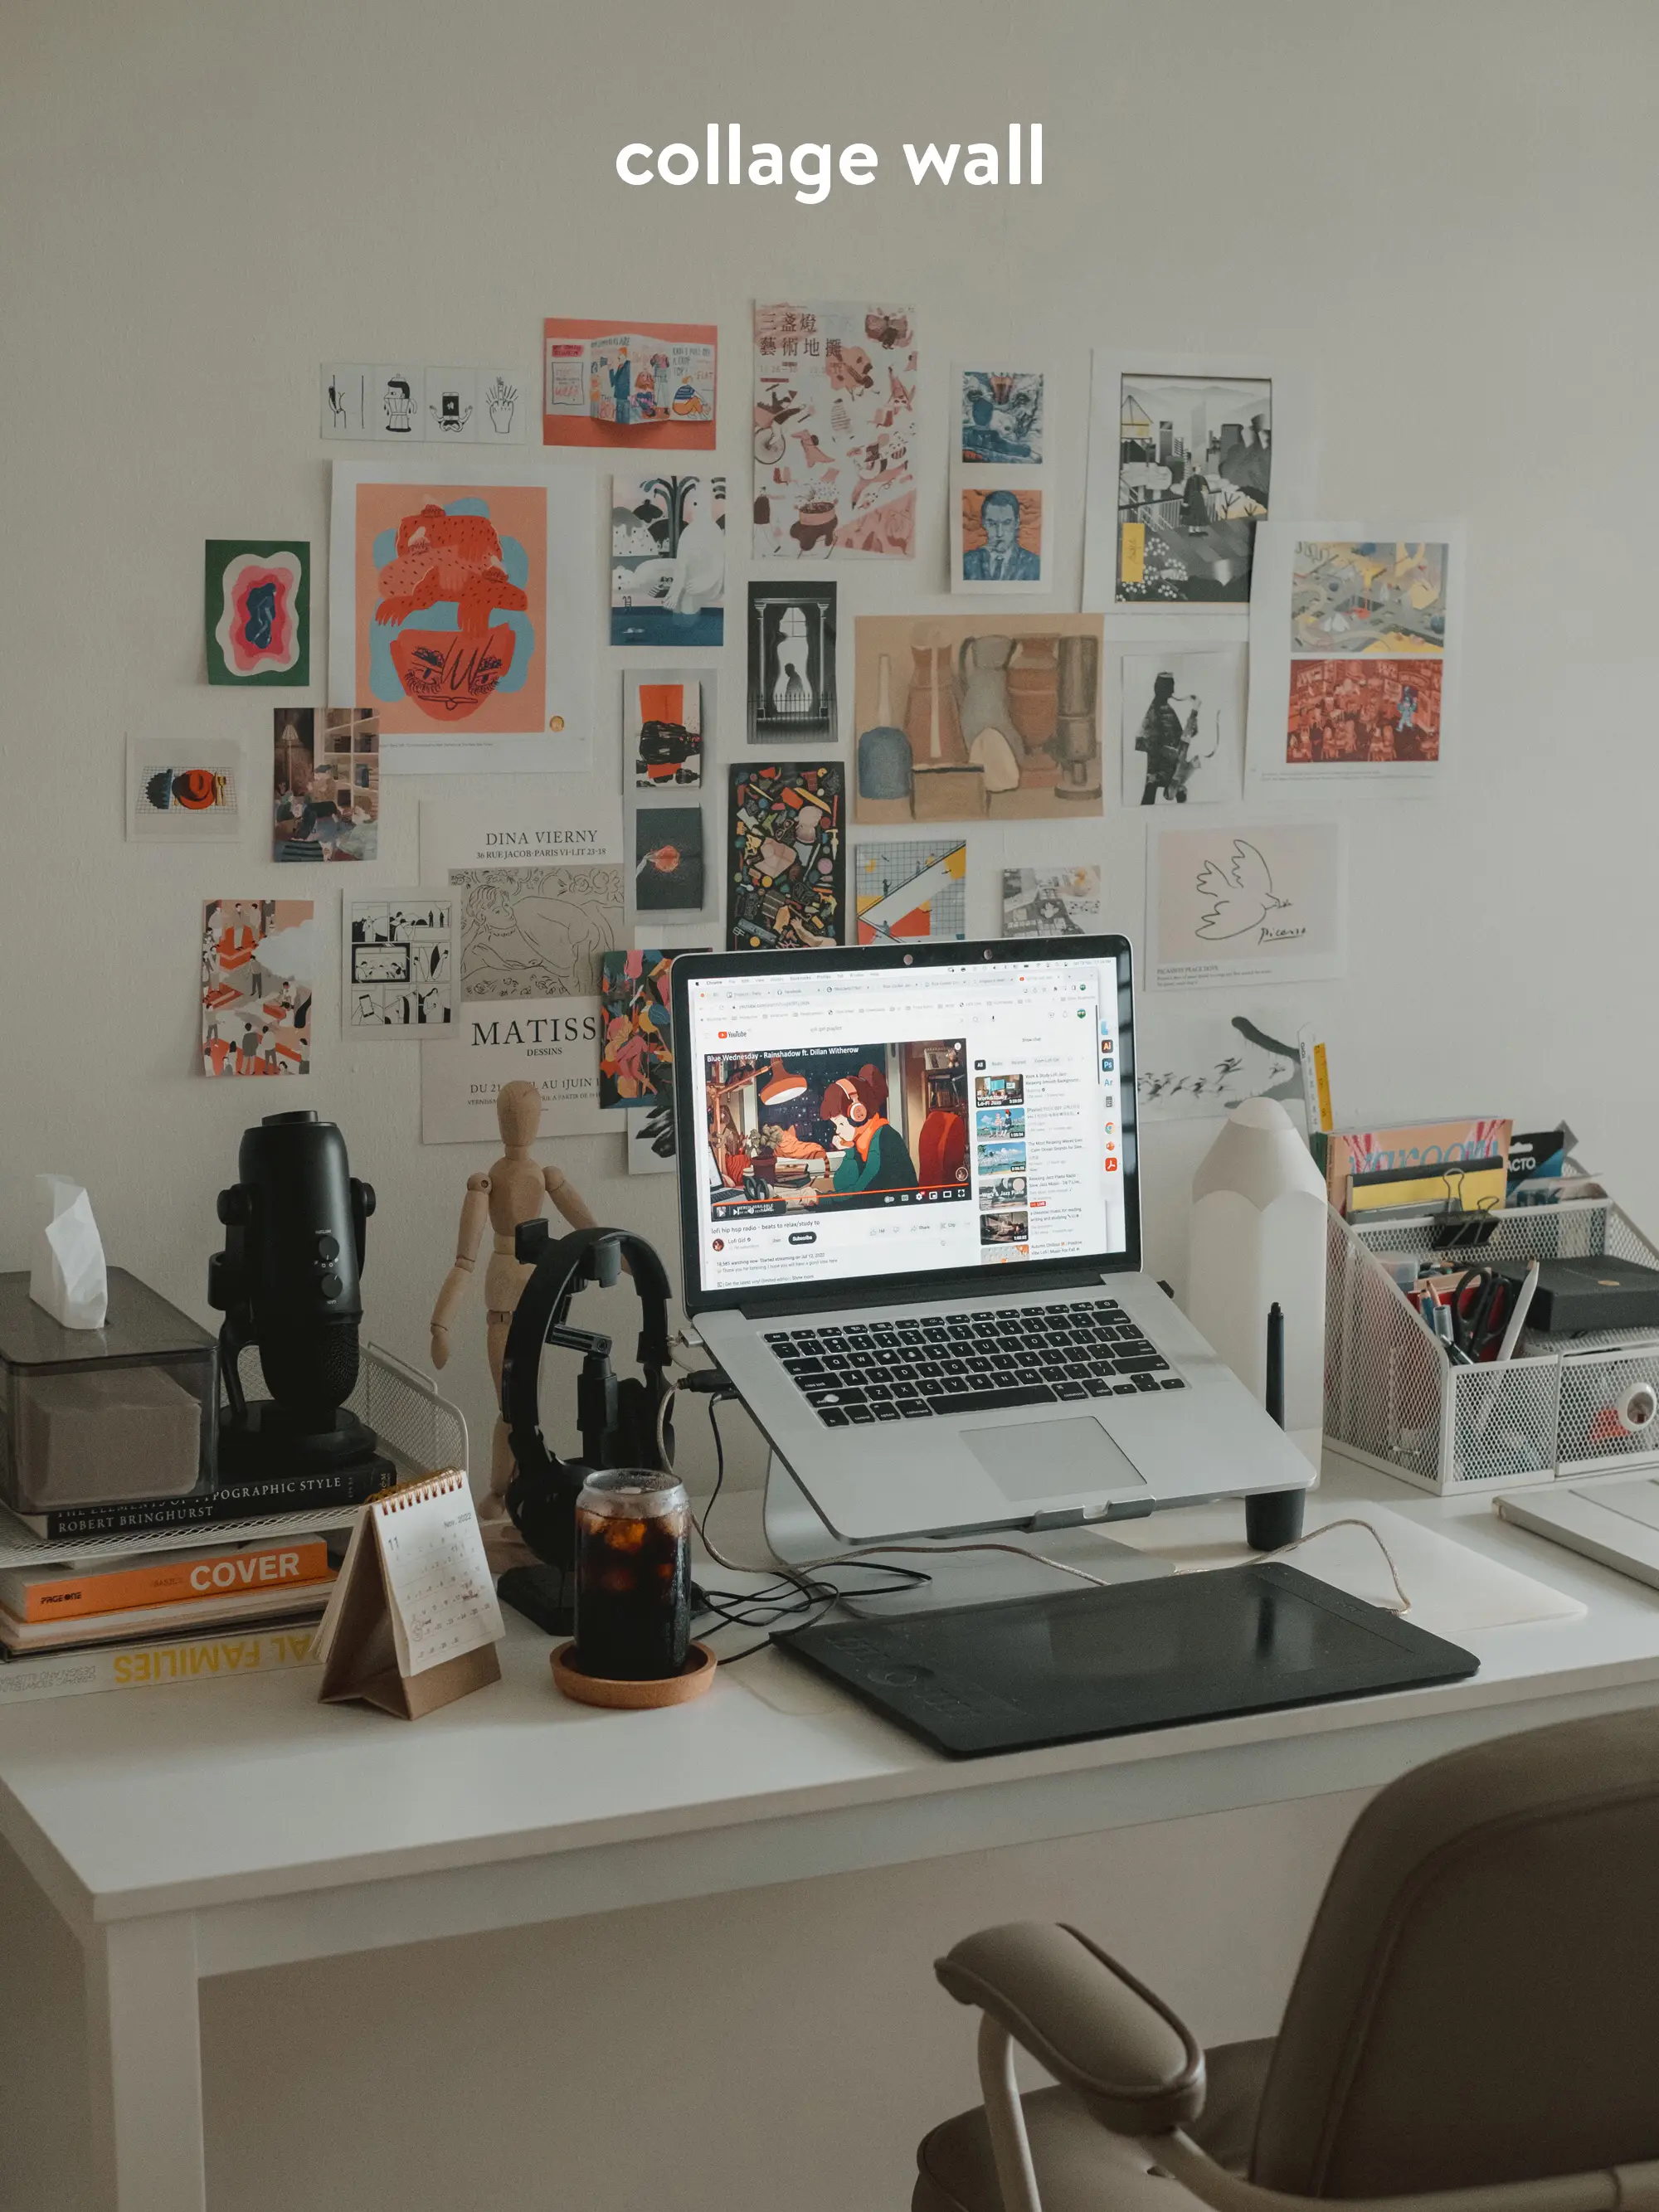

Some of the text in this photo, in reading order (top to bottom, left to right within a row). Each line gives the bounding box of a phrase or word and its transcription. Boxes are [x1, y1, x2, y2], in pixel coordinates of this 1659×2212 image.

[761, 312, 816, 333] 三盞燈
[486, 830, 598, 845] DINA VIERNY
[471, 1017, 596, 1046] MATISS
[728, 1030, 747, 1038] YouTube
[527, 1047, 562, 1057] DESSINS
[470, 1084, 487, 1093] DU
[542, 1081, 557, 1089] AU
[1104, 1078, 1112, 1087] Ar
[300, 1477, 342, 1491] STYLE
[58, 1517, 114, 1533] ROBERT
[119, 1506, 214, 1526] BRINGHURST
[443, 1513, 472, 1529] Nov. 2022
[387, 1536, 400, 1551] 11
[189, 1552, 299, 1591] COVER
[41, 1596, 63, 1605] PAGE
[113, 1641, 260, 1685] FAMILIES
